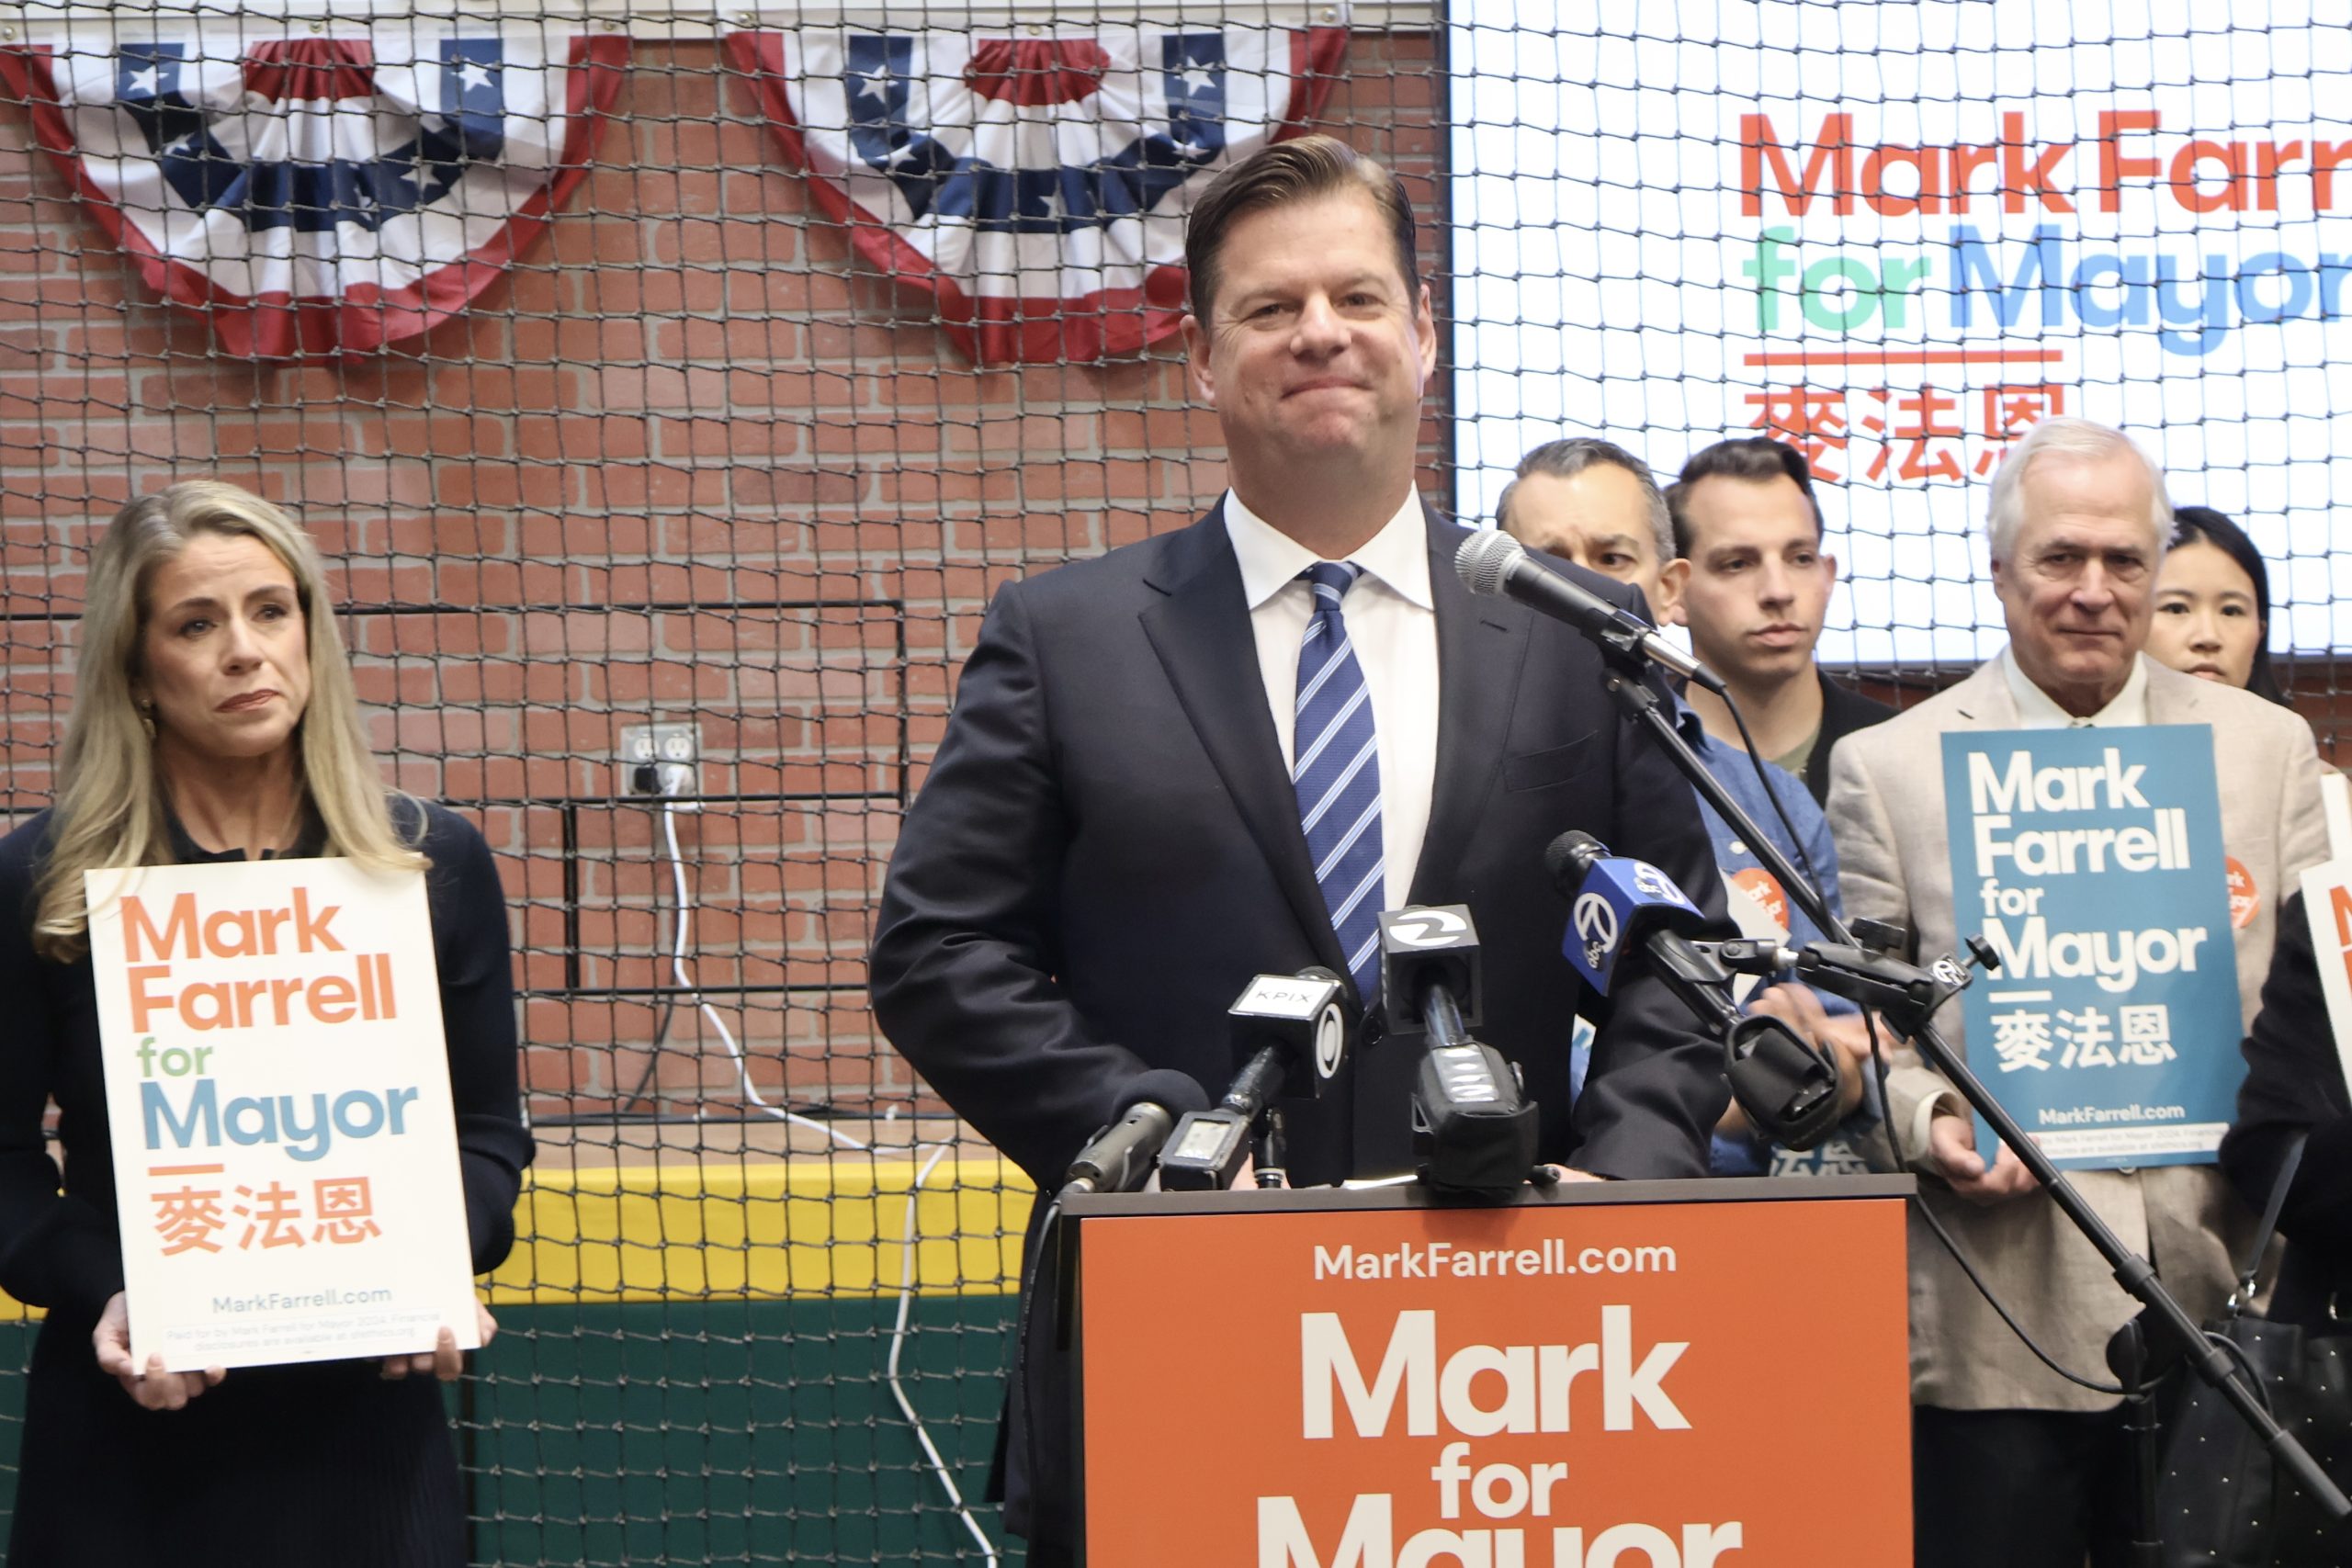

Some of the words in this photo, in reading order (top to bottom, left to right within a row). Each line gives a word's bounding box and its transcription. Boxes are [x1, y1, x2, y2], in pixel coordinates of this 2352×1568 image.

[1740, 111, 2076, 217] Mark
[2098, 110, 2352, 214] Farr
[1743, 226, 1931, 332] for
[1968, 747, 2151, 814] Mark
[1973, 807, 2190, 877] Farrell
[119, 887, 344, 963] Mark
[1979, 877, 2044, 917] for
[1982, 916, 2208, 993] Mayor
[128, 953, 396, 1033] Farrell
[1255, 989, 1314, 1003] KPIX
[136, 1036, 213, 1078] for
[1990, 1004, 2177, 1073] 麥法恩
[140, 1077, 418, 1162] Mayor
[2039, 1103, 2186, 1126] MarkFarrell.com
[149, 1176, 383, 1258] 麥法恩
[1314, 1237, 1677, 1280] MarkFarrell.com
[212, 1287, 392, 1314] MarkFarrell.com
[1301, 1305, 1692, 1439] Mark
[1430, 1442, 1567, 1518] for
